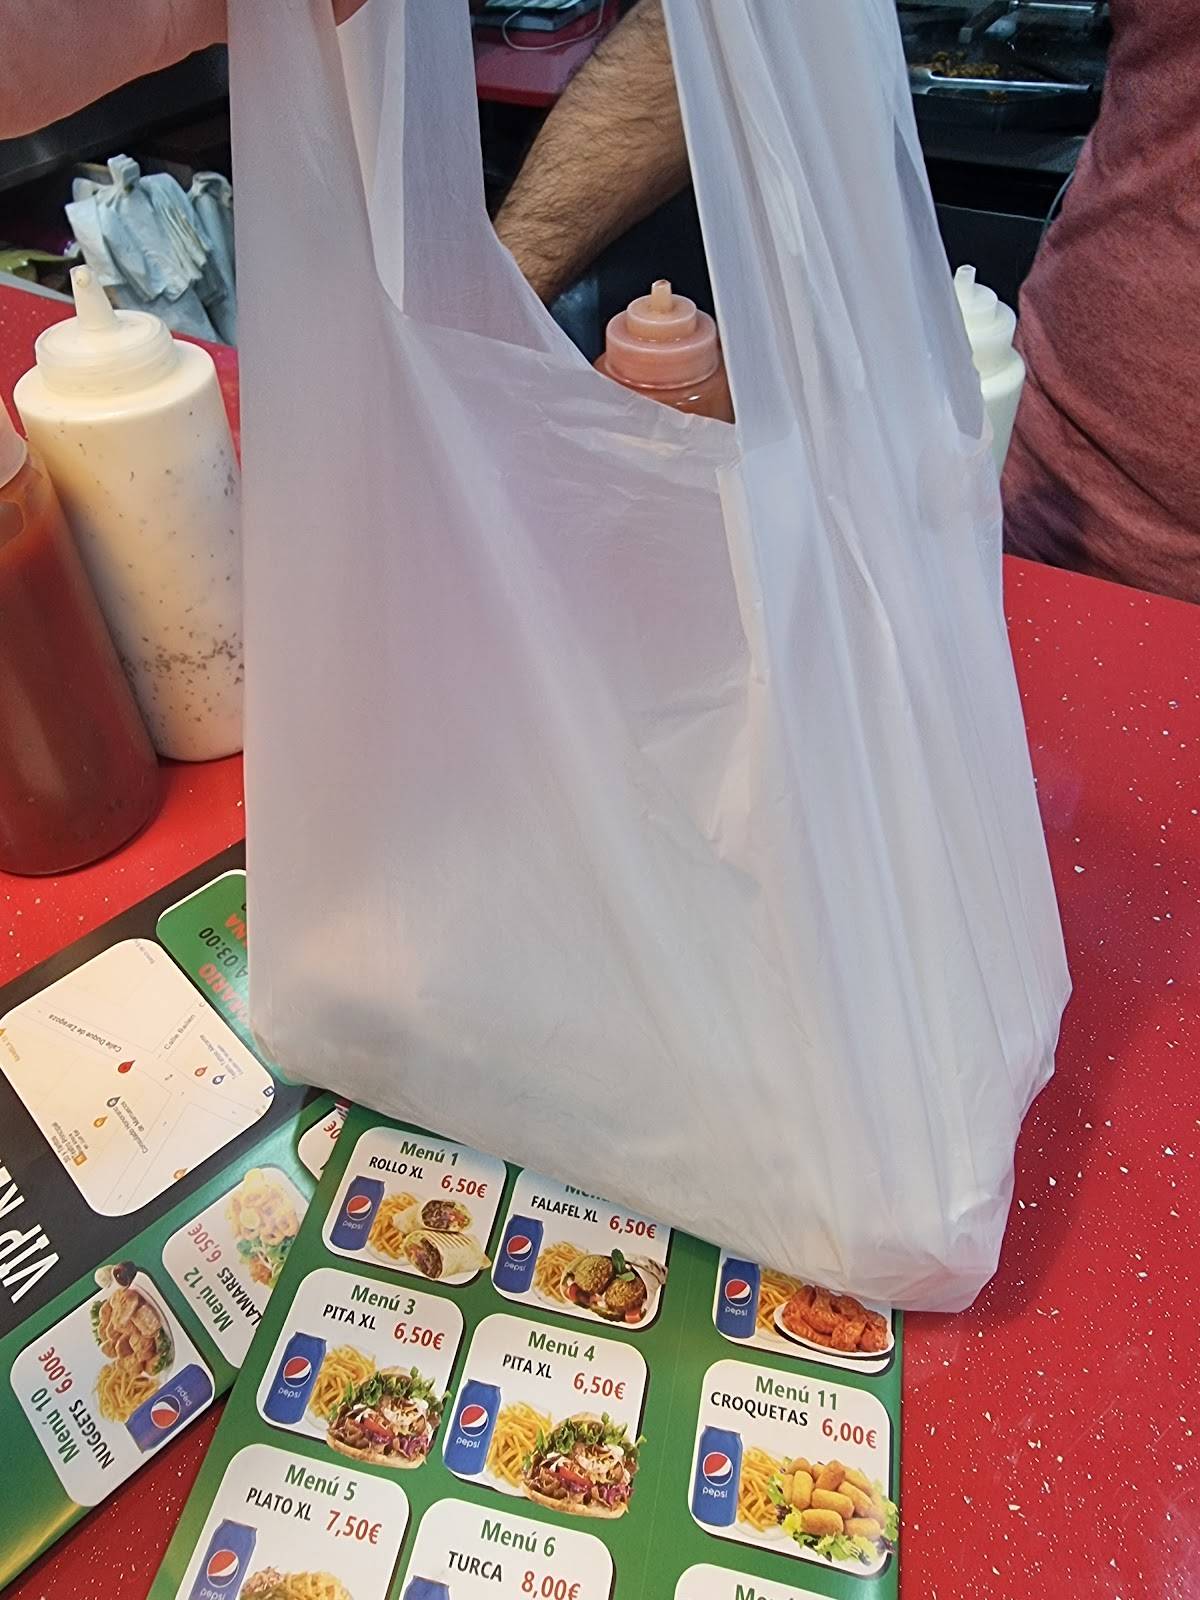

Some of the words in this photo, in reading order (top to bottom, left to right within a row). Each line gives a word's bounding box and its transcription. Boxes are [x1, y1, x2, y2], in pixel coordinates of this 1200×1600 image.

[198, 928, 238, 966] 03:00
[400, 1141, 448, 1166] Menú
[452, 1152, 459, 1166] 1
[369, 1156, 407, 1176] ROLLO
[408, 1166, 424, 1180] XL
[441, 1174, 488, 1198] 6,50€
[342, 1218, 364, 1230] pepsi
[531, 1195, 580, 1218] FALAFEL
[583, 1208, 598, 1223] XL
[609, 1216, 657, 1239] 6,50€
[188, 1223, 222, 1263] 6,50€
[184, 1267, 204, 1288] 12
[504, 1260, 528, 1272] pepsi
[196, 1286, 234, 1332] Menú
[216, 1266, 263, 1326] LAMARES
[350, 1284, 400, 1312] Menú
[404, 1298, 416, 1316] 3
[724, 1305, 748, 1318] pepsi
[322, 1304, 356, 1327] PITA
[357, 1314, 376, 1330] XL
[393, 1322, 445, 1350] 6,50€
[528, 1330, 579, 1357] Menú
[583, 1345, 596, 1362] 4
[38, 1346, 72, 1394] 6,00€
[502, 1354, 532, 1375] PITA
[532, 1362, 553, 1380] XL
[573, 1372, 626, 1401] 6,50€
[31, 1388, 52, 1412] 10
[278, 1386, 302, 1400] pepsi
[756, 1376, 810, 1404] Menú
[817, 1390, 838, 1412] 11
[42, 1408, 80, 1464] Menú
[69, 1399, 114, 1470] NUGGETS
[710, 1391, 809, 1427] CROQUETAS
[822, 1418, 878, 1450] 6,00€
[456, 1436, 482, 1450] pepsi
[284, 1464, 340, 1495] Menú
[345, 1482, 358, 1502] 5
[702, 1486, 728, 1499] pepsi
[246, 1487, 293, 1518] PLATO
[294, 1502, 312, 1522] XL
[325, 1510, 384, 1544] 7,50€
[480, 1520, 537, 1553] Menú
[543, 1536, 556, 1558] 6
[448, 1551, 503, 1582] TURCA
[521, 1570, 582, 1600] 8,00€
